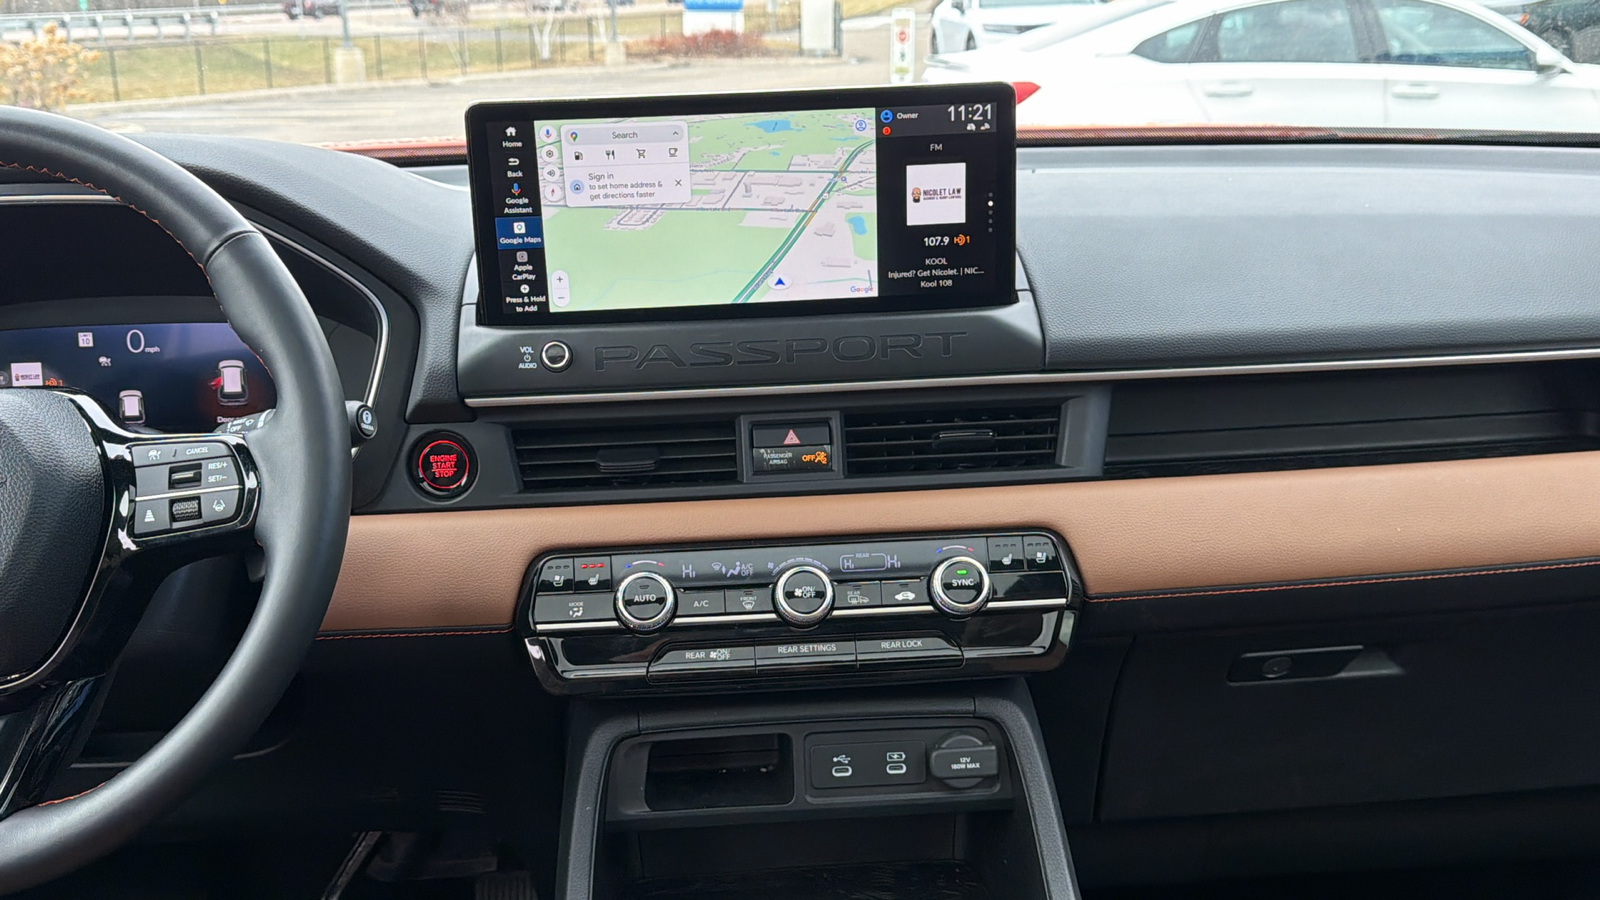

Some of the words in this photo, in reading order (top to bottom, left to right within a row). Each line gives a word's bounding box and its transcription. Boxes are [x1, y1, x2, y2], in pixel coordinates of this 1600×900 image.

[948, 104, 992, 121] 11:21
[612, 131, 638, 139] Search
[588, 173, 605, 182] Sign
[924, 236, 949, 246] 107.9
[888, 270, 916, 278] Injured?
[595, 333, 968, 371] PASSPORT
[186, 447, 209, 455] CANCEL
[430, 454, 457, 462] ENGINE
[951, 578, 974, 587] SYNC
[634, 594, 656, 603] AUTO
[800, 644, 836, 652] SETTINGS
